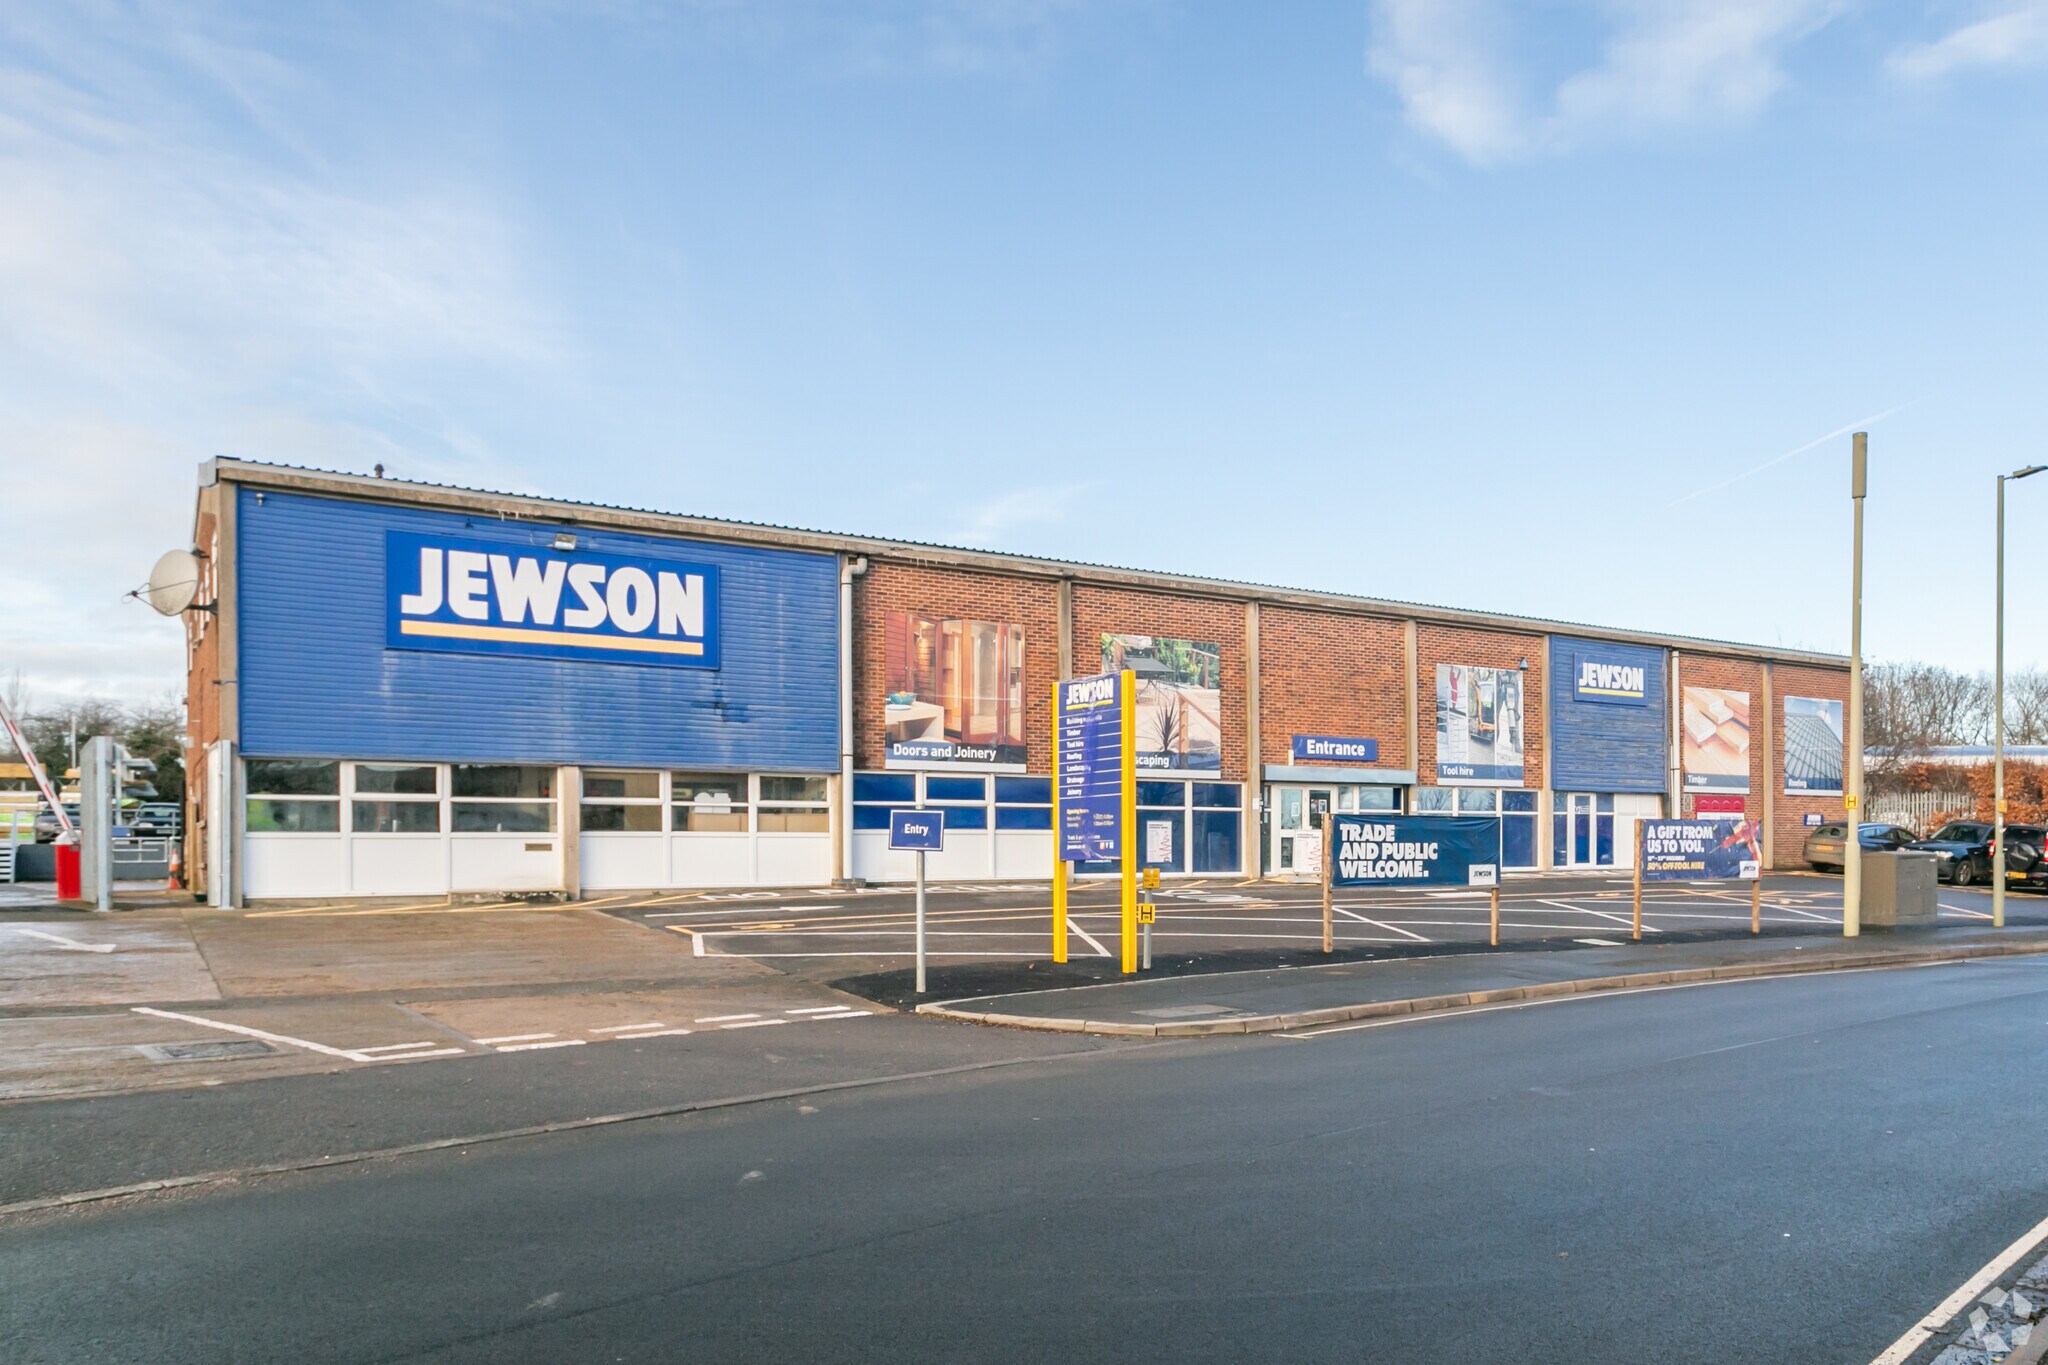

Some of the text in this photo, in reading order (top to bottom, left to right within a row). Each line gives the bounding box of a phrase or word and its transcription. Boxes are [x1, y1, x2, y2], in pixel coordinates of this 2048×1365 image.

[401, 547, 703, 637] JEWSON
[1579, 662, 1644, 691] JEWSON
[893, 743, 996, 761] Doors and Joinery
[1307, 739, 1366, 756] Entrance
[1442, 765, 1474, 775] Tool hire
[1688, 775, 1708, 785] Timber
[904, 823, 929, 836] Entry
[1340, 824, 1396, 842] TRADE
[1647, 826, 1713, 839] A GIFT FROM
[1339, 842, 1438, 860] AND PUBLIC
[1647, 840, 1705, 853] US TO YOU.
[1339, 860, 1429, 878] WELCOME.
[1141, 906, 1152, 920] H
